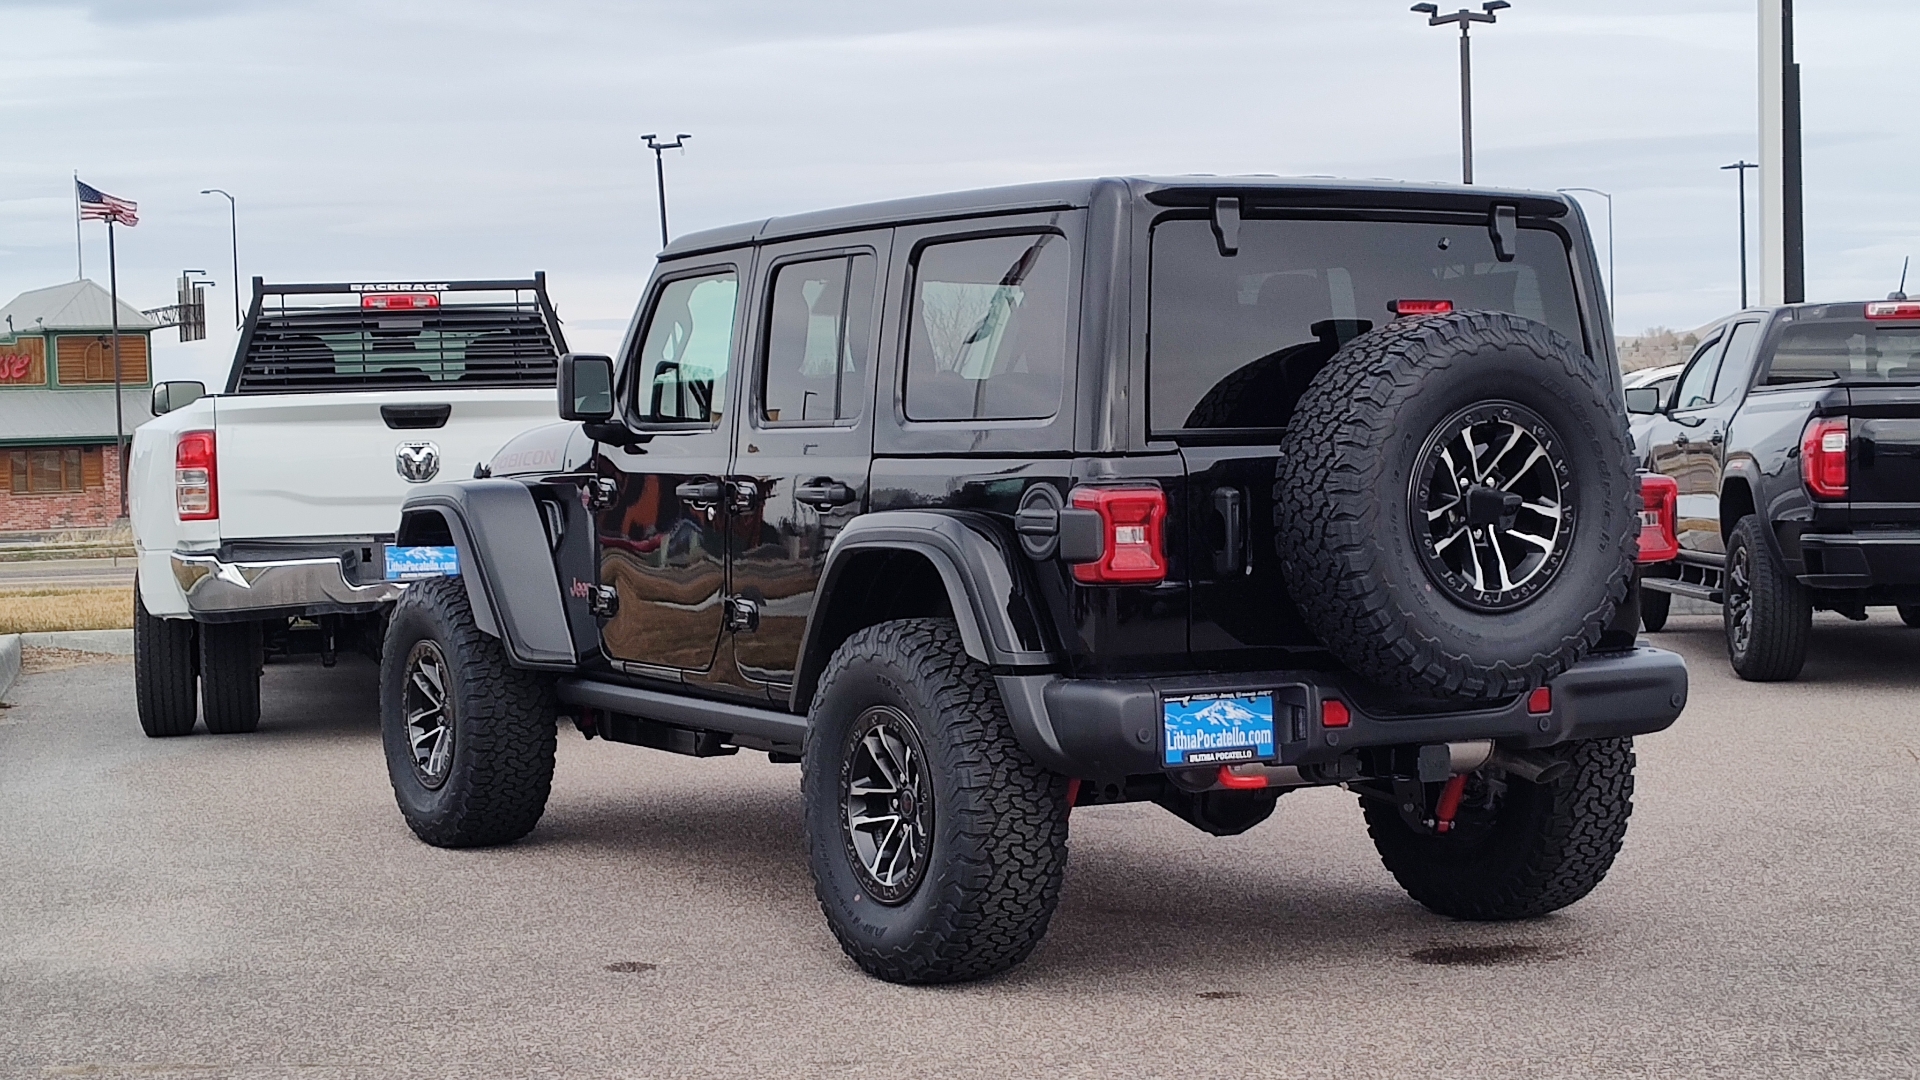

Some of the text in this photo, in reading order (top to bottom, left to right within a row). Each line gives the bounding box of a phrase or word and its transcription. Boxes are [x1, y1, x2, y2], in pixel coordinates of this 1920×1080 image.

[350, 283, 450, 291] BACKRACK
[1166, 727, 1271, 751] LithiaPocatello.com
[1215, 750, 1252, 761] POCATELLO
